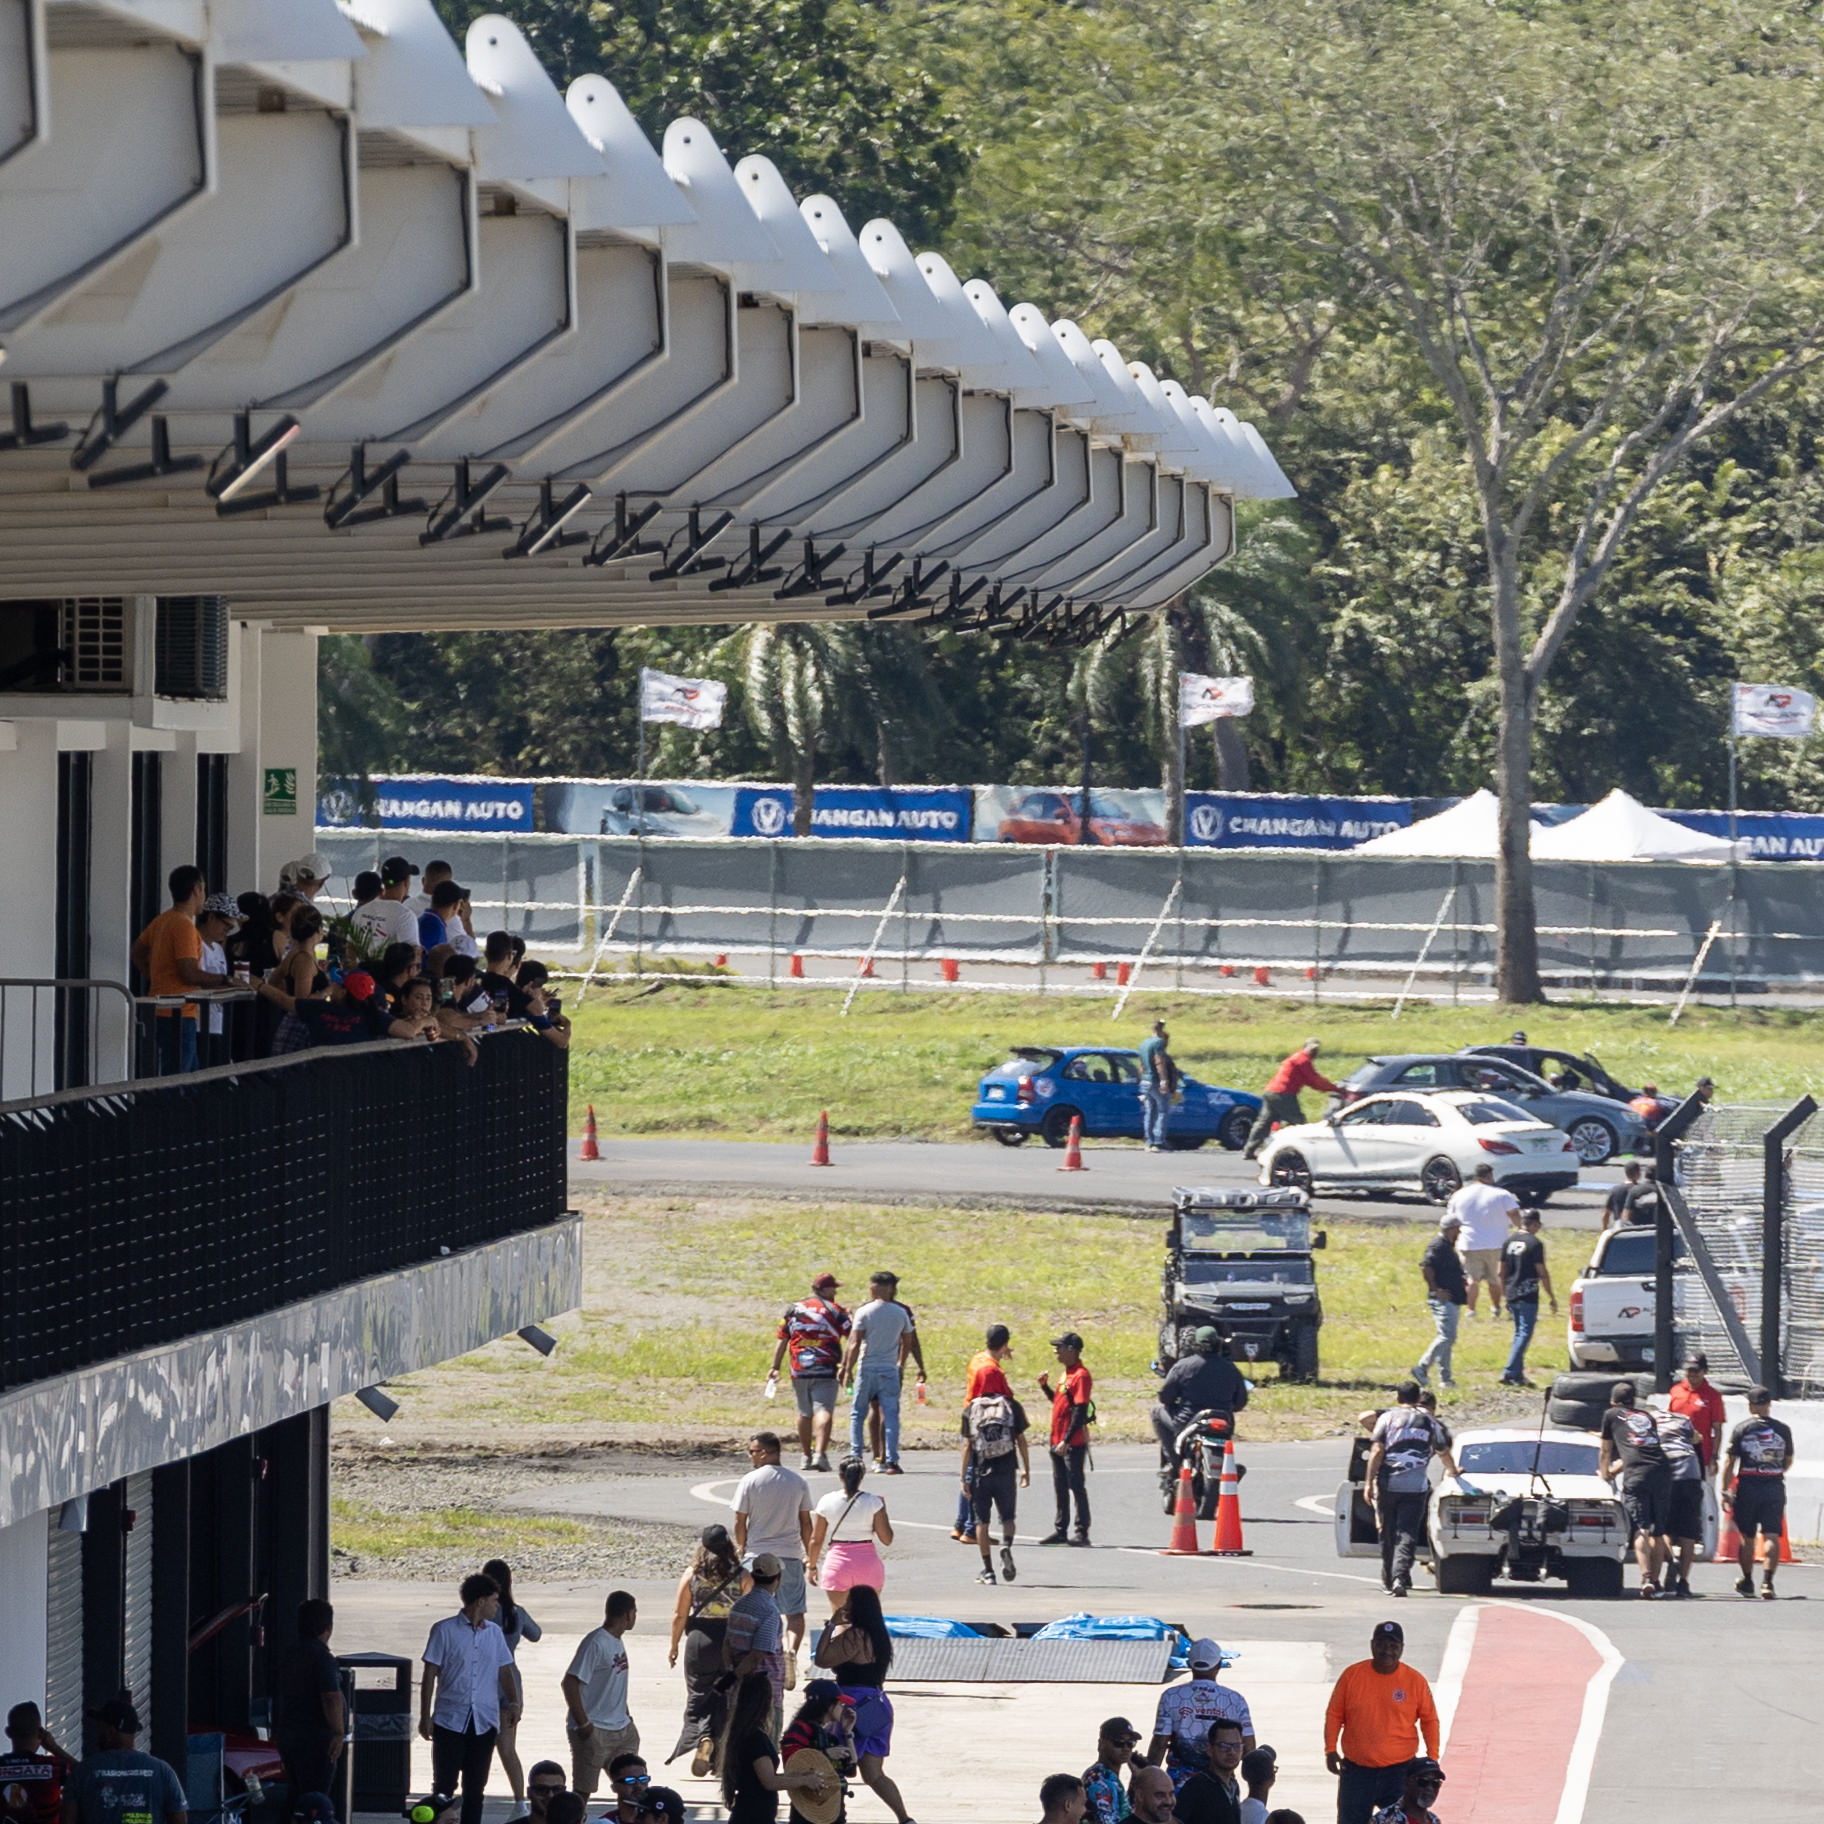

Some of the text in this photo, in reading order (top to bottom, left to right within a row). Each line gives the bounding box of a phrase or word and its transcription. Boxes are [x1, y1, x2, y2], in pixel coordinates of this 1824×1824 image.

[465, 801, 524, 820] AUTO
[897, 810, 959, 830] AUTO
[1229, 816, 1336, 837] CHANGAN
